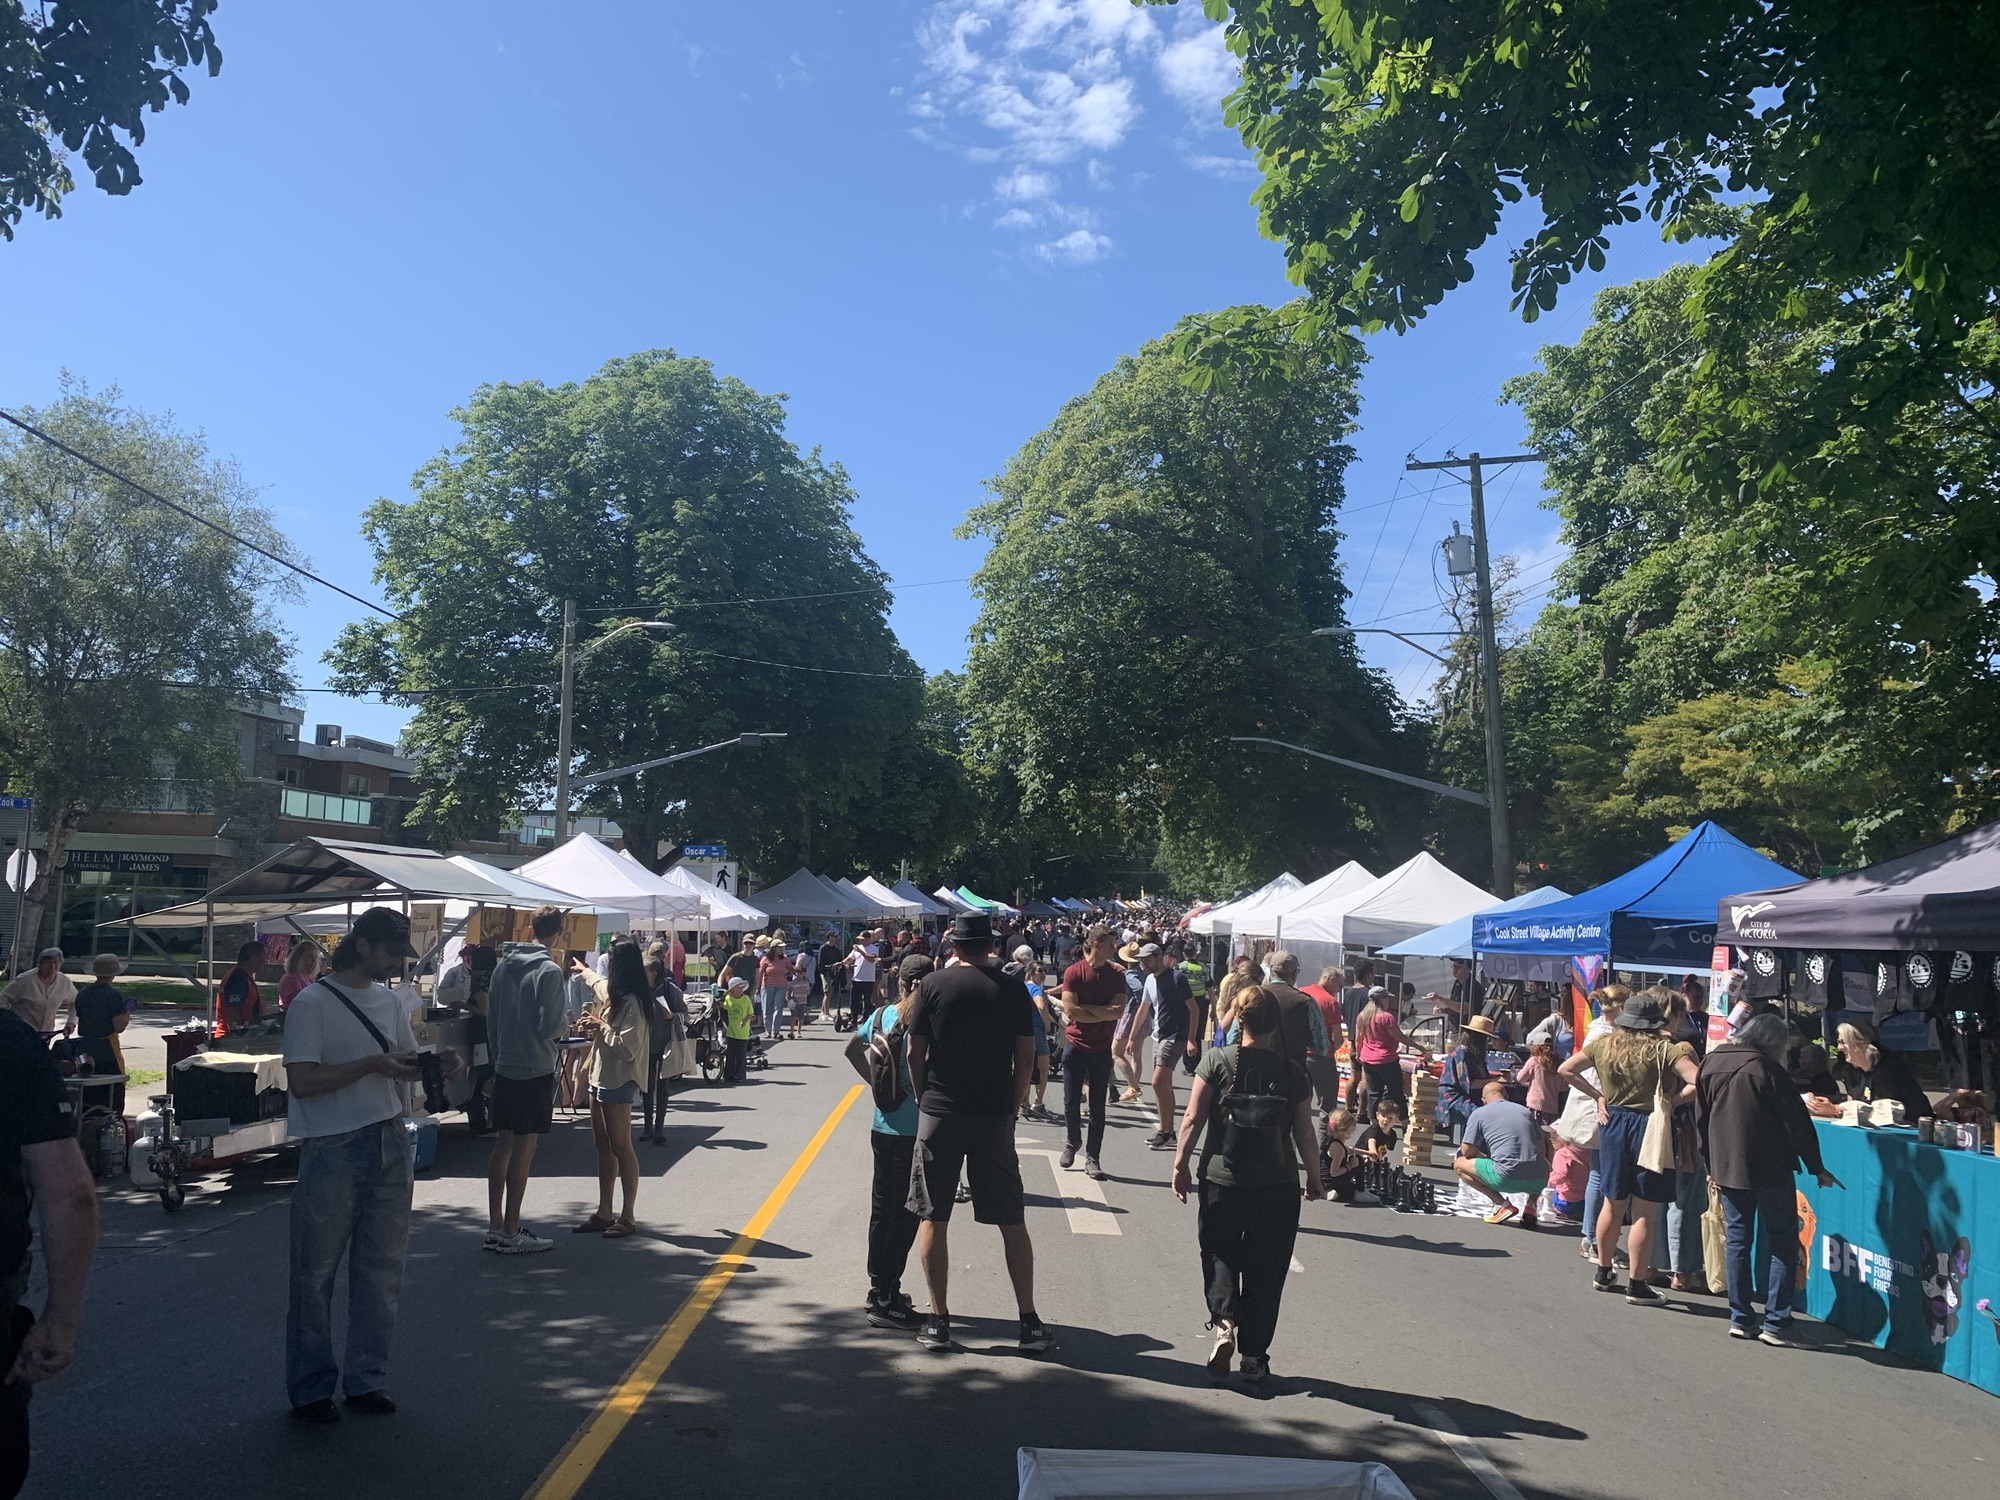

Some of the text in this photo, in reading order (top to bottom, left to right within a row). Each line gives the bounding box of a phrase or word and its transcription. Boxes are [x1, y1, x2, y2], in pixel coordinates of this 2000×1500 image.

[0, 798, 14, 808] ook
[685, 847, 706, 855] Oscar
[72, 852, 114, 863] HELM
[122, 854, 169, 863] RAYMOND
[129, 863, 160, 871] JAMES
[1495, 924, 1601, 942] Cook Street Village Activity Centre
[1740, 928, 1778, 940] VICTORIA
[1822, 1235, 1874, 1284] BFF
